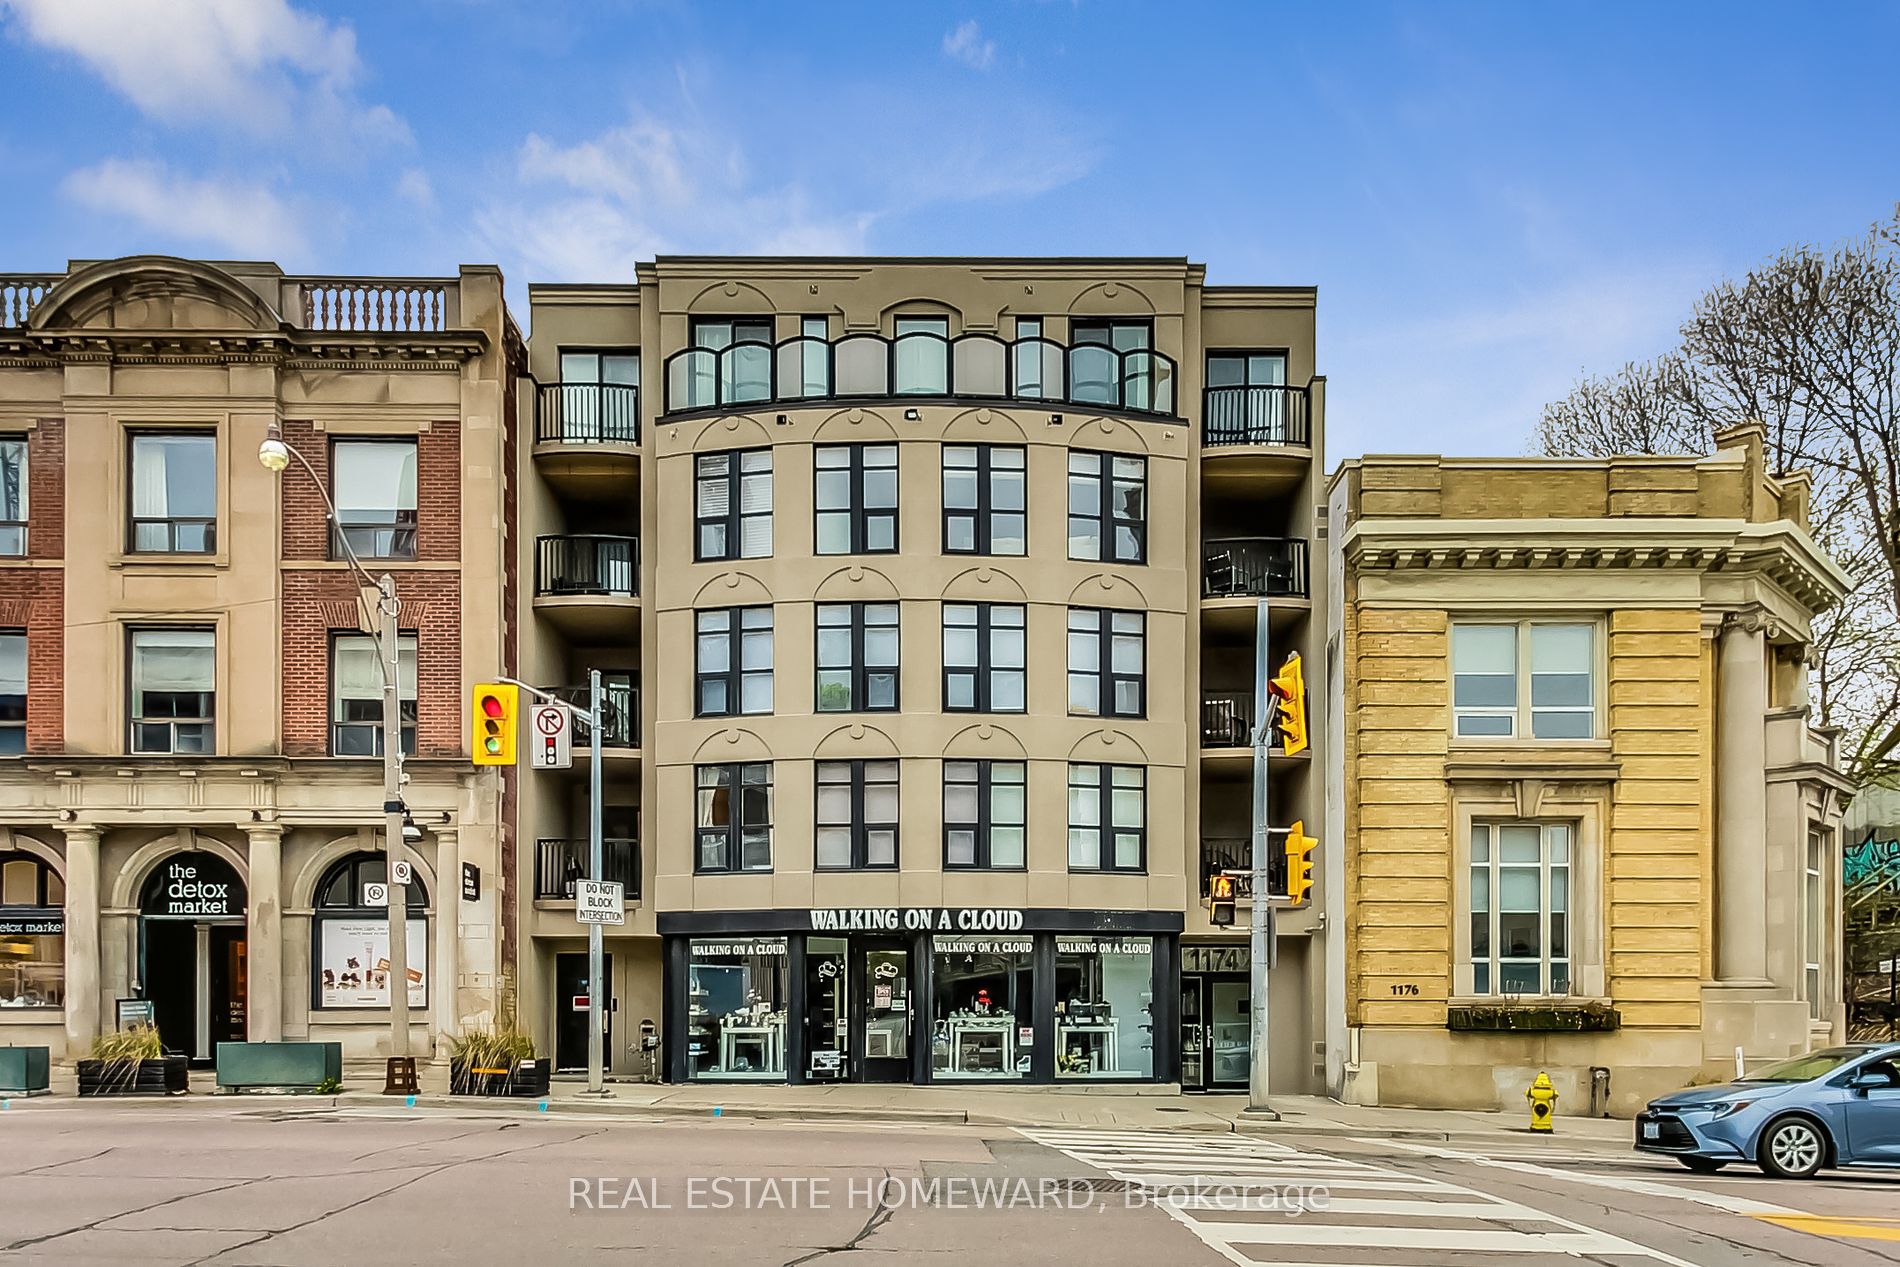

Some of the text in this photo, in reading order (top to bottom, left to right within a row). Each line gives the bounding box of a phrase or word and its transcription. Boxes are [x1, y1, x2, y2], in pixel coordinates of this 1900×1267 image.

[169, 863, 197, 878] the
[168, 879, 228, 898] detox
[586, 883, 614, 895] DO NOT
[168, 898, 228, 914] market
[587, 896, 613, 907] BLOCK
[579, 909, 622, 921] NTERSECTION
[810, 909, 1023, 931] WALKING ON A CLOUD
[692, 944, 786, 956] WALKING ON A CLOUD
[934, 942, 1033, 953] WALKING ON A CLOUD
[1057, 942, 1151, 954] WALKING ON A CLOUD
[1190, 949, 1239, 971] 1174
[1390, 984, 1419, 995] 1176
